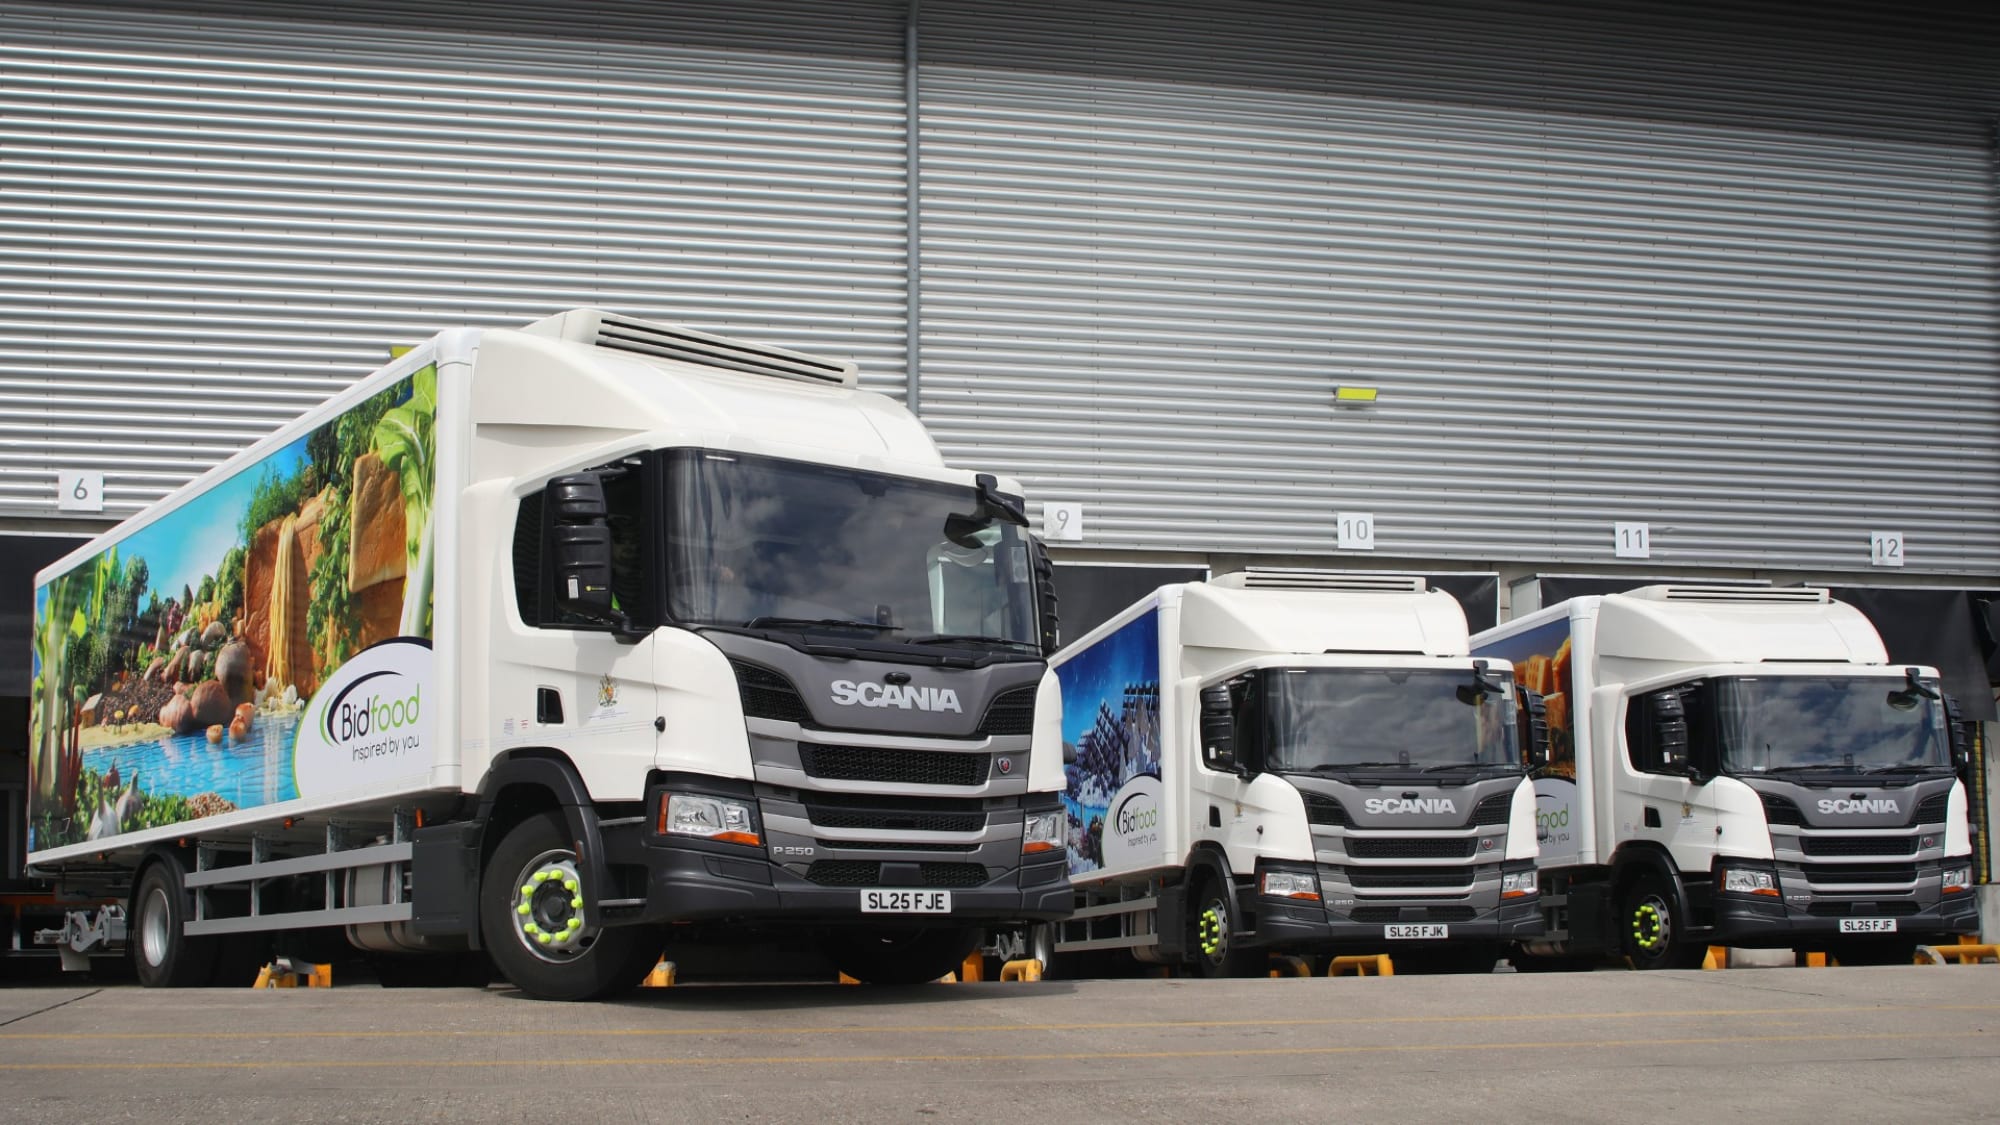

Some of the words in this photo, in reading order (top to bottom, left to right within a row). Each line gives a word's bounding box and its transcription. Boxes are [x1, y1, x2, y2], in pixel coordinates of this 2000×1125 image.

[74, 478, 88, 500] 6
[1057, 509, 1069, 530] 9
[1344, 519, 1367, 540] 10
[1622, 529, 1643, 549] 11
[1876, 538, 1899, 558] 12
[830, 679, 963, 714] SCANIA
[342, 682, 420, 742] Bidfood
[352, 736, 388, 763] Inspired
[389, 736, 400, 757] by
[402, 734, 420, 756] you
[1364, 798, 1457, 814] SCANIA
[1817, 799, 1900, 814] SCANIA
[773, 846, 783, 855] P
[784, 846, 815, 856] 250
[868, 892, 910, 910] SL25
[914, 892, 945, 910] FJE
[1390, 926, 1419, 937] SL25
[1422, 926, 1443, 937] FJK
[1844, 920, 1871, 931] SL25
[1873, 920, 1892, 931] FJF
